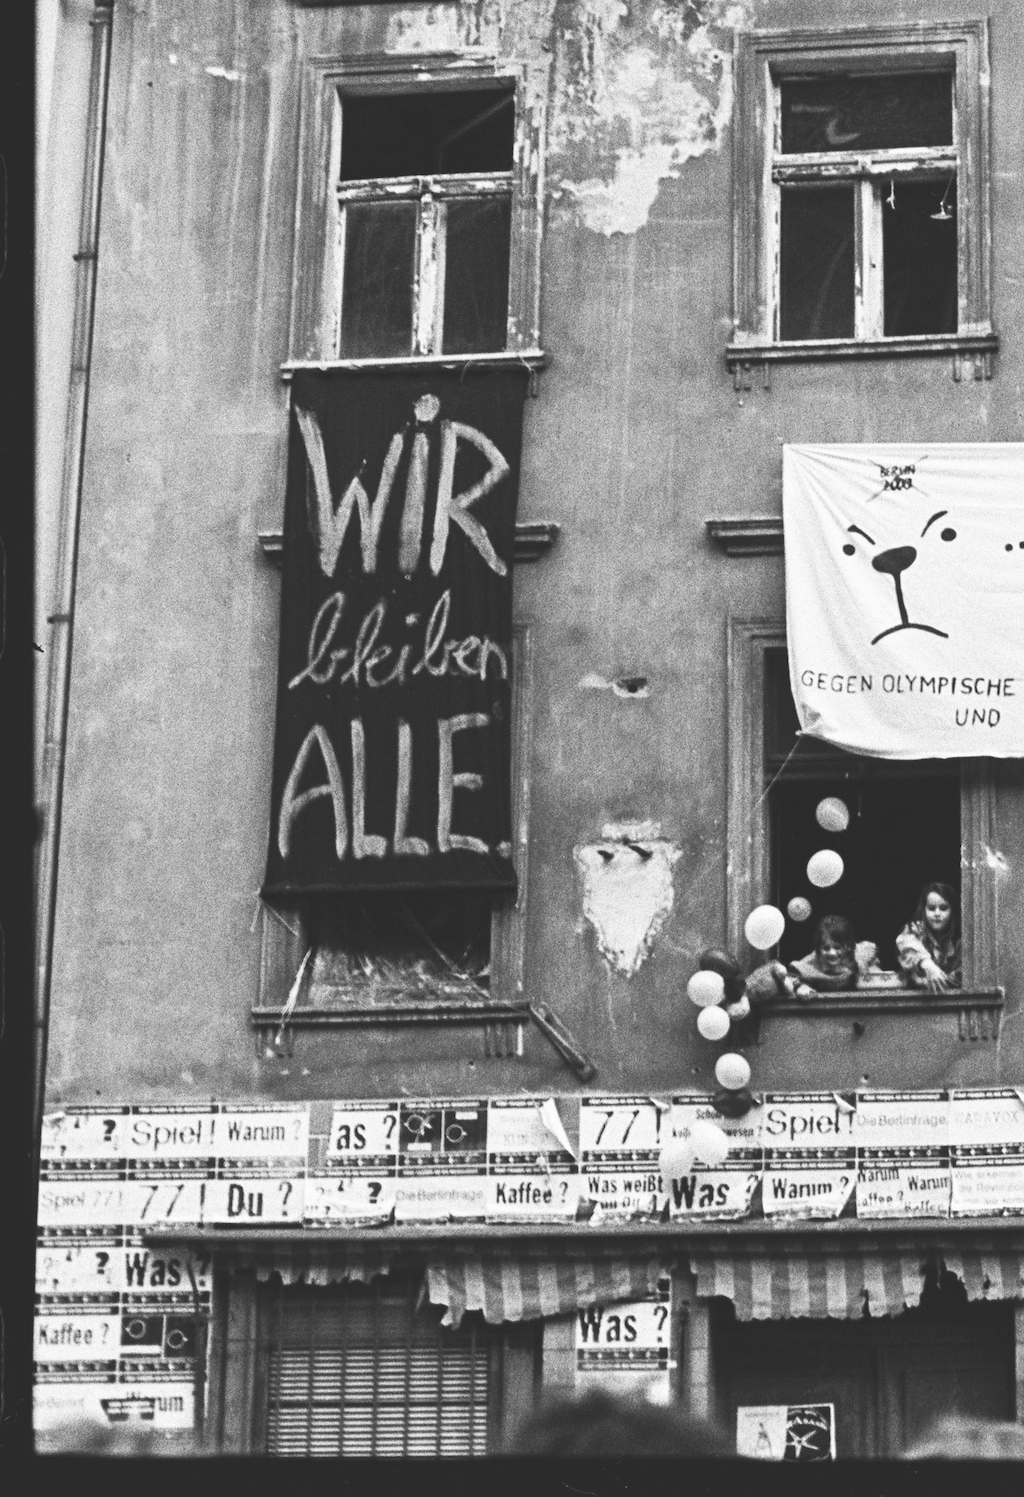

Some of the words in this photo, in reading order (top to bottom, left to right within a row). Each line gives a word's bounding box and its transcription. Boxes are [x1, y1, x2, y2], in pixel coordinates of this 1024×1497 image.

[288, 589, 508, 689] bleiben
[801, 670, 873, 693] GEGEN
[882, 674, 1015, 697] OLYMPISCHE
[955, 708, 1001, 728] UND
[278, 713, 512, 860] ALLE.
[228, 1121, 285, 1141] Warum
[336, 1123, 366, 1150] as
[383, 1115, 397, 1151] ?
[227, 1183, 264, 1218] Du
[278, 1181, 292, 1217] ?
[496, 1181, 552, 1205] Kaffee
[559, 1181, 568, 1203] ?
[588, 1176, 617, 1193] Was
[623, 1175, 663, 1193] weißt
[672, 1175, 729, 1209] Was
[772, 1178, 832, 1199] Warum
[840, 1176, 849, 1194] ?
[138, 1184, 185, 1219] 77
[125, 1252, 181, 1286] Was
[38, 1323, 93, 1344] Kaffee
[102, 1323, 109, 1344] ?
[578, 1306, 638, 1342] Was
[652, 1306, 668, 1342] ?
